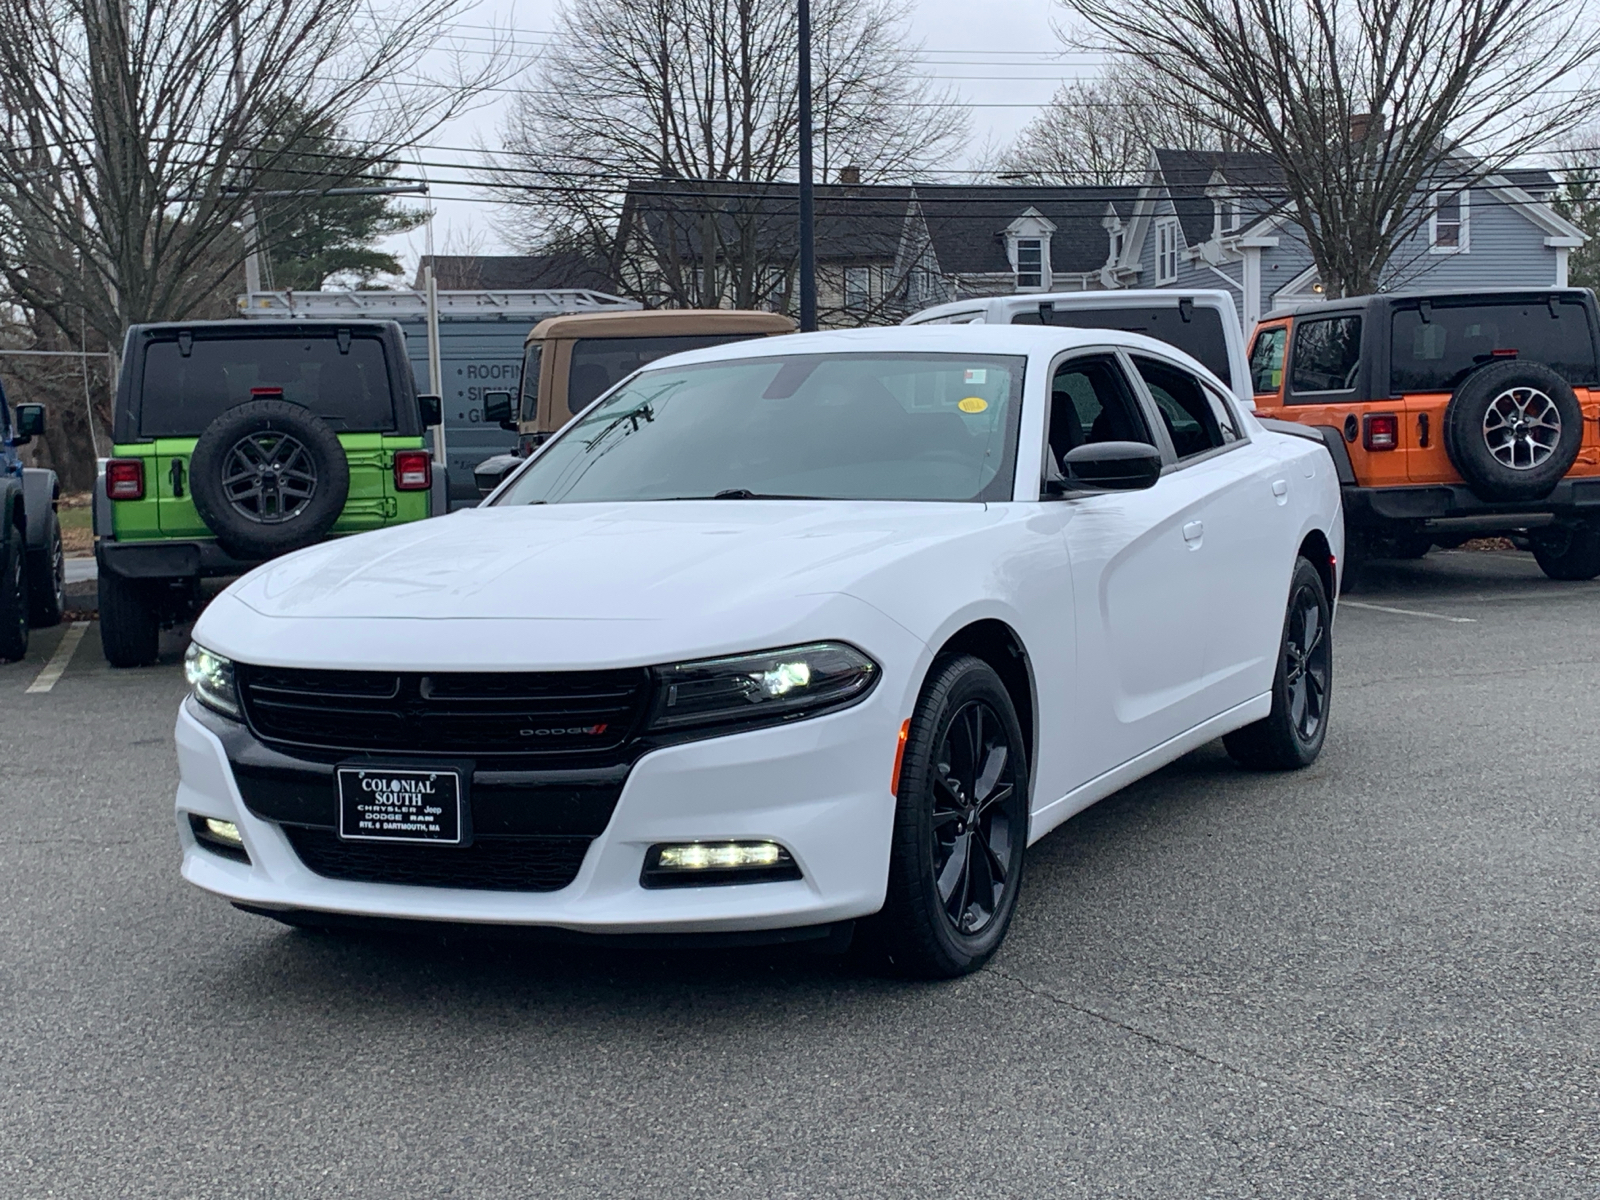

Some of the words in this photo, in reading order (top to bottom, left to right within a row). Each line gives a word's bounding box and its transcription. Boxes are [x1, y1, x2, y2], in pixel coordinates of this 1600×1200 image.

[519, 726, 595, 736] DODGE
[362, 778, 435, 793] COLONIAL
[375, 792, 422, 806] SOUTH
[357, 805, 416, 813] CHRYSLER
[423, 806, 442, 815] Jeep
[365, 812, 403, 821] DODGE
[383, 822, 428, 832] DARTMOUTH,
